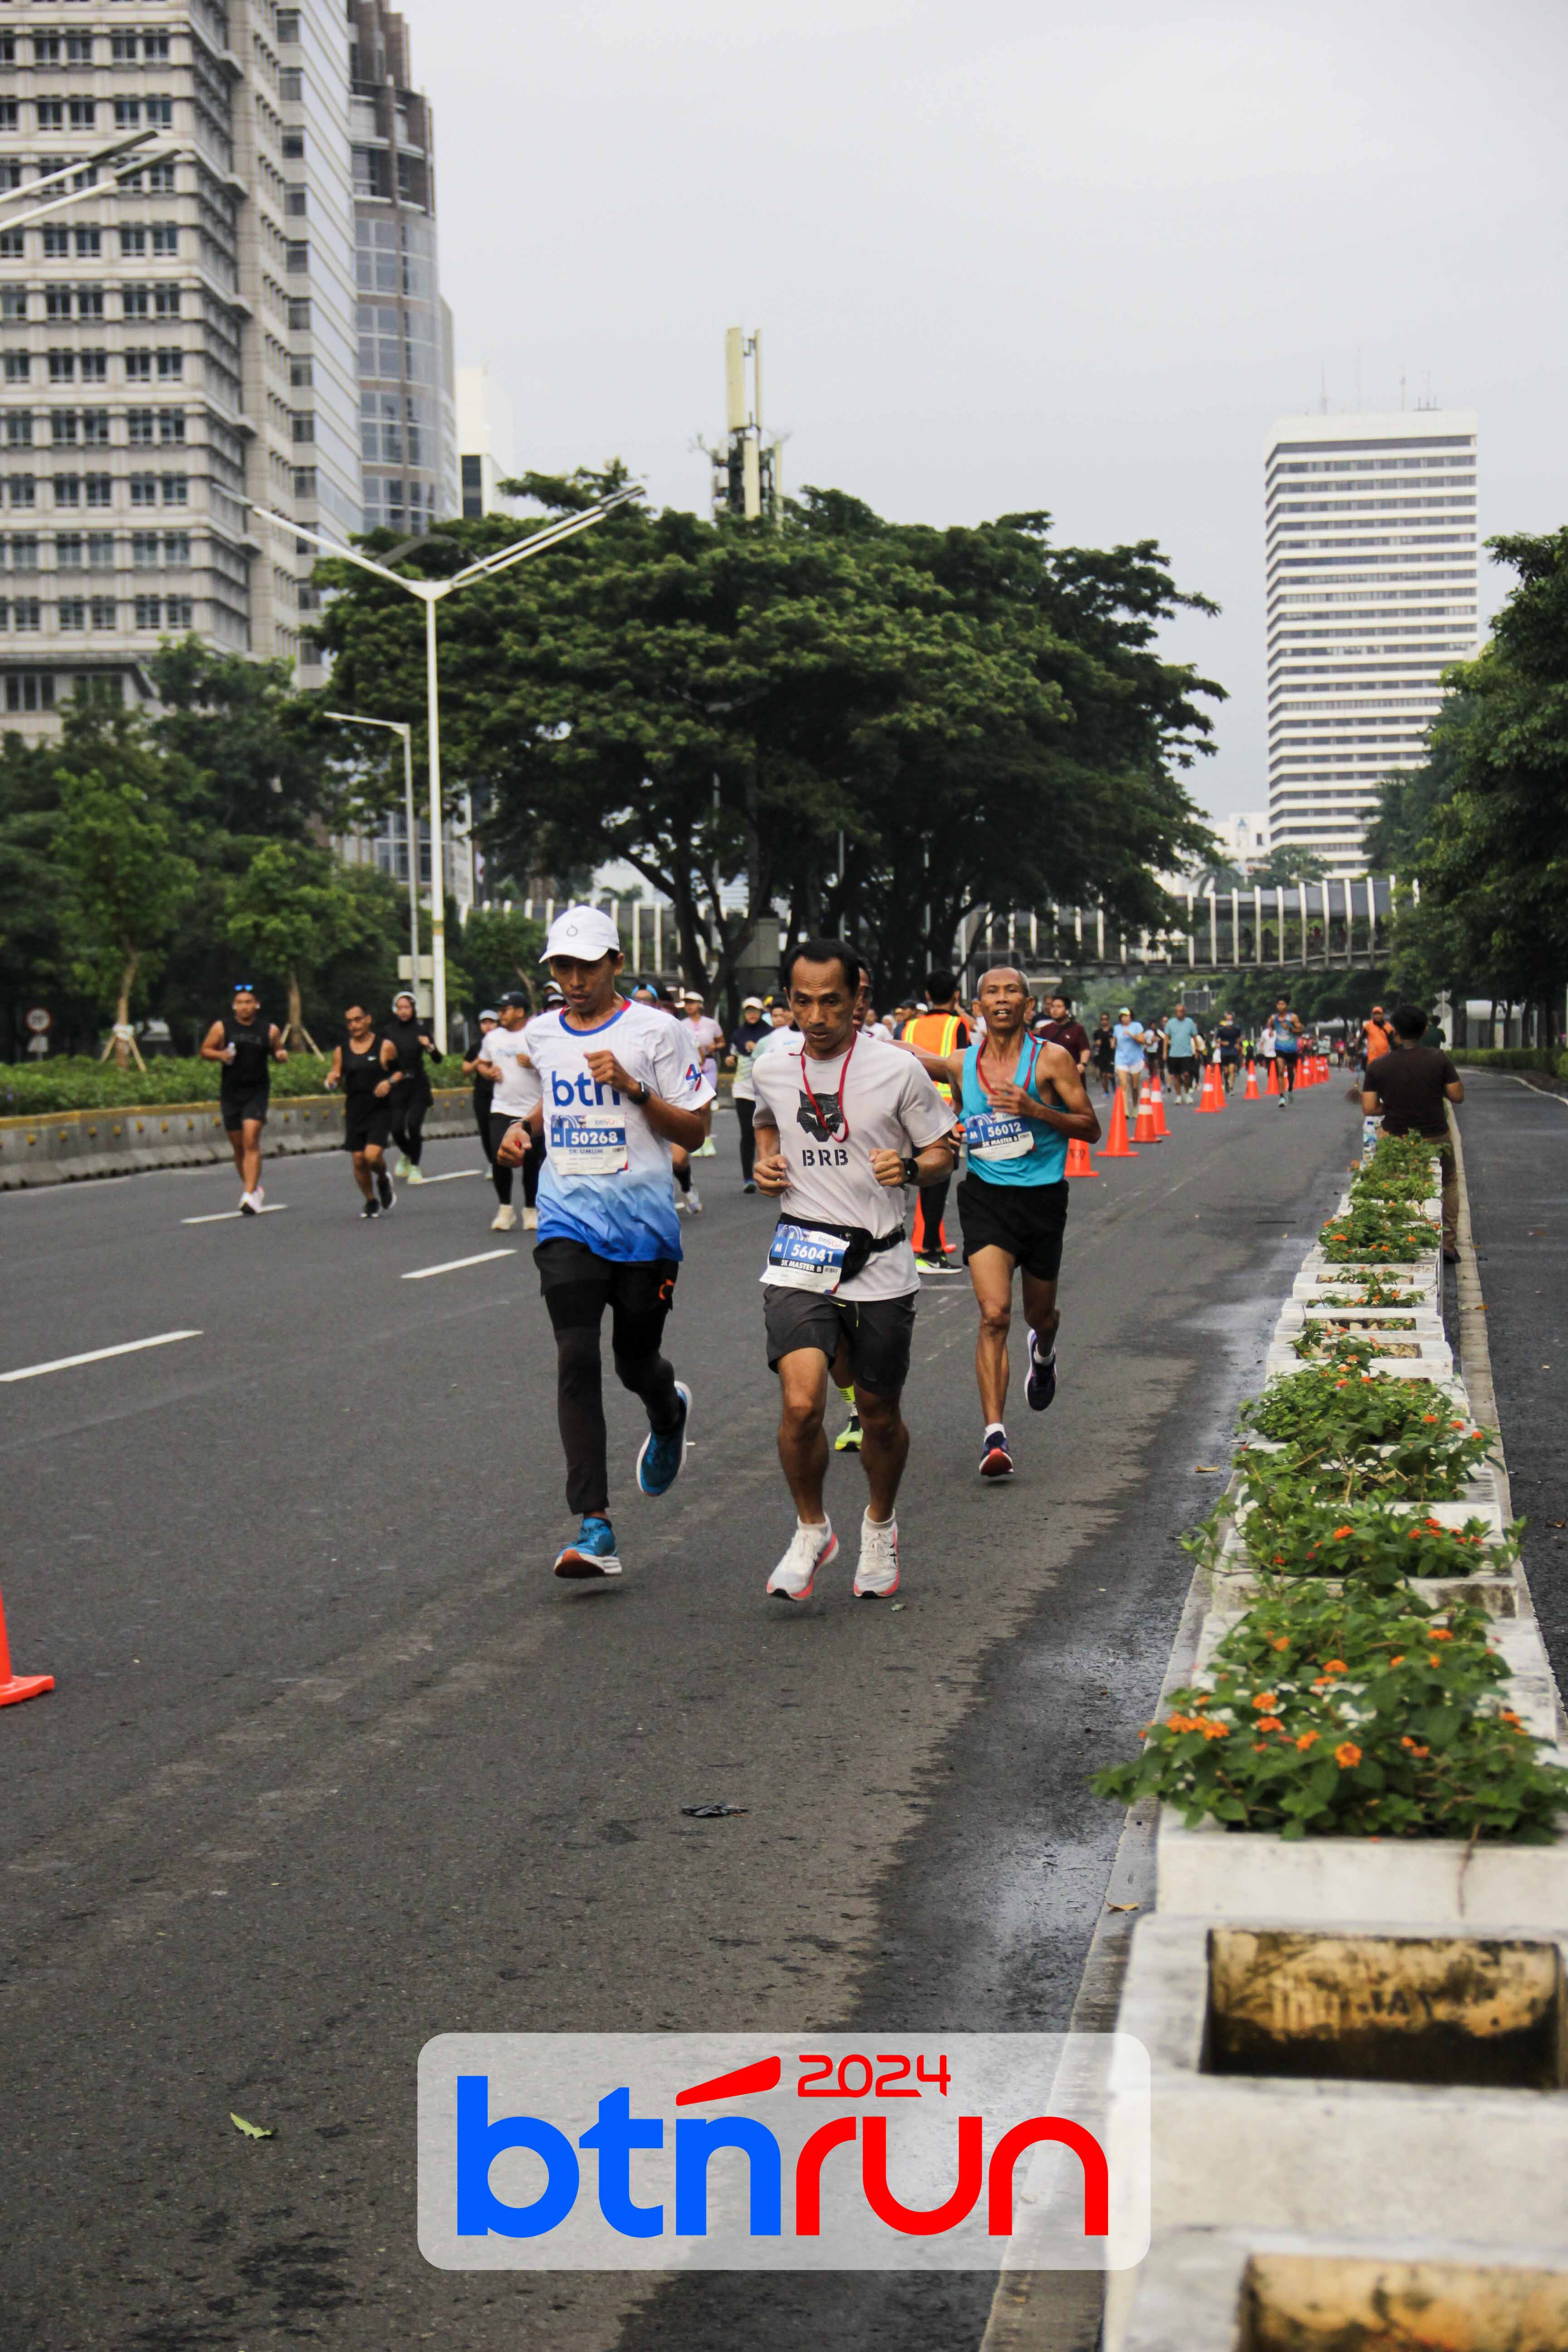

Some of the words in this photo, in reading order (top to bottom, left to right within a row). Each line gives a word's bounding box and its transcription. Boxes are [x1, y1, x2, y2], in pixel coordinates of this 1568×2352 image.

[552, 1071, 620, 1107] btn
[987, 1122, 1022, 1137] 56012
[554, 1133, 561, 1142] M
[571, 1131, 618, 1145] 50268
[991, 1136, 1013, 1146] MASTER
[802, 1149, 848, 1166] BRB
[774, 1243, 783, 1252] M
[791, 1244, 833, 1263] 56041
[789, 1261, 814, 1271] MASTER
